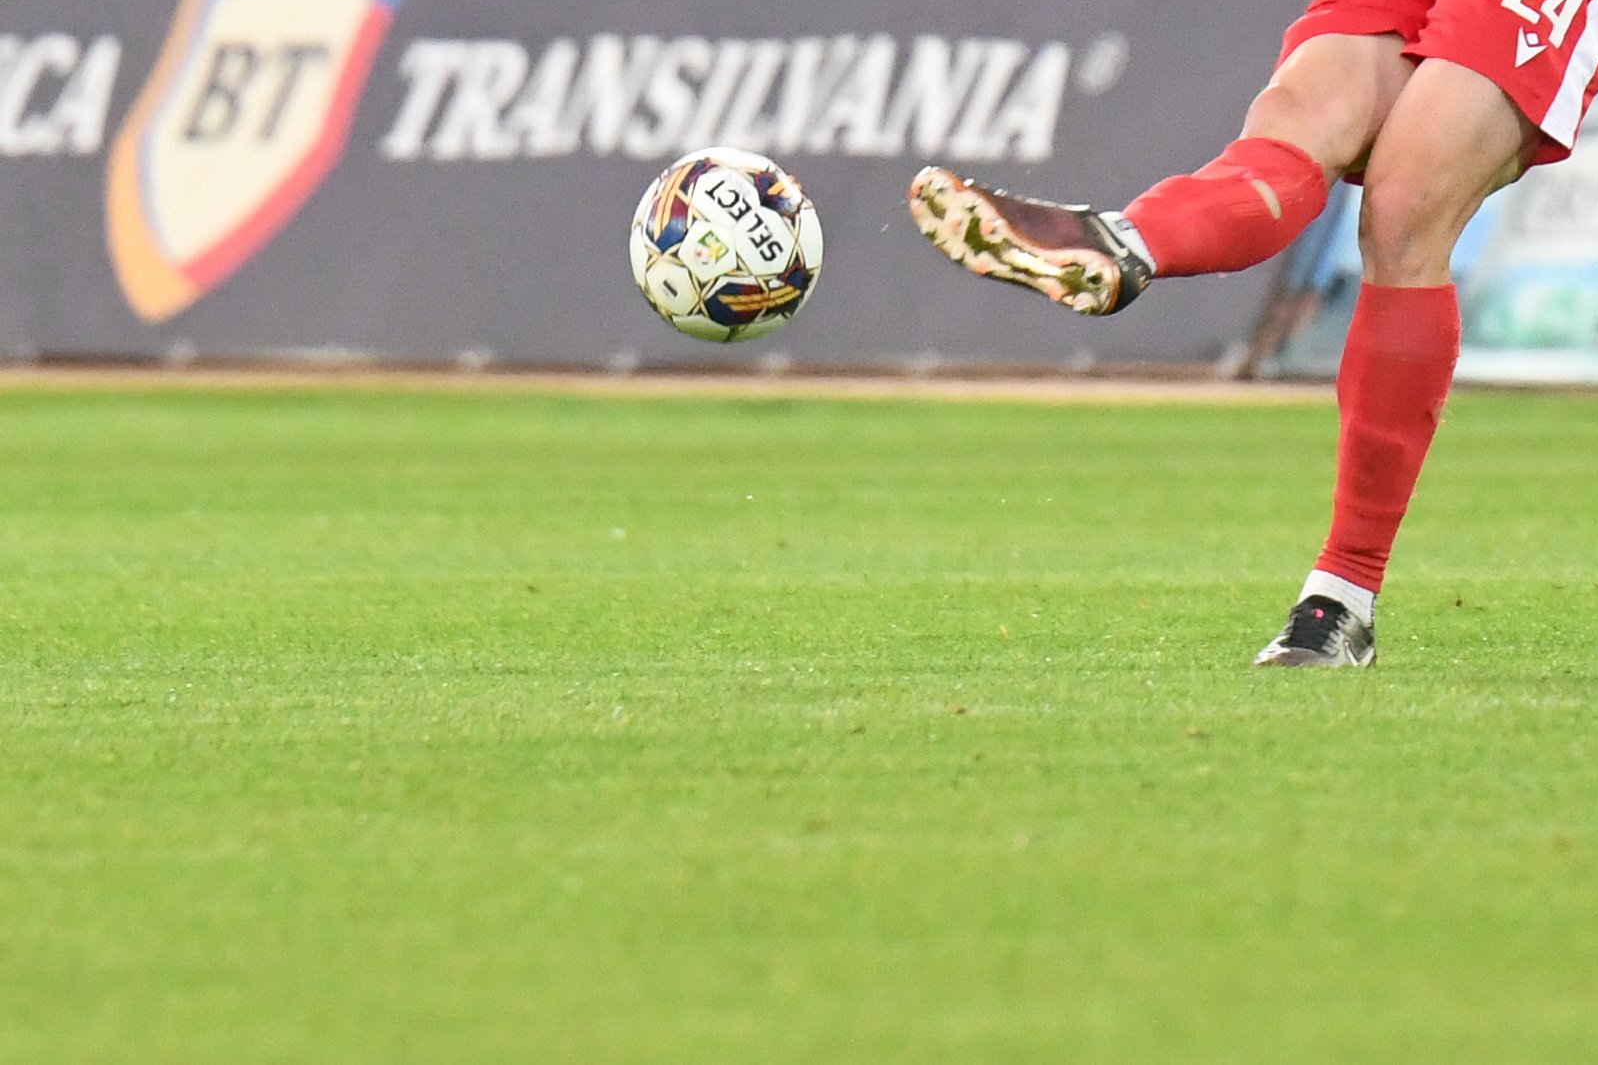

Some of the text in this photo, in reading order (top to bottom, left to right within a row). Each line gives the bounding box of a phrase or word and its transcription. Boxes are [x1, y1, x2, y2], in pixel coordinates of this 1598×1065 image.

[183, 40, 330, 146] BT
[380, 32, 1071, 164] TRANSILVANIA
[704, 180, 784, 263] SELECT
